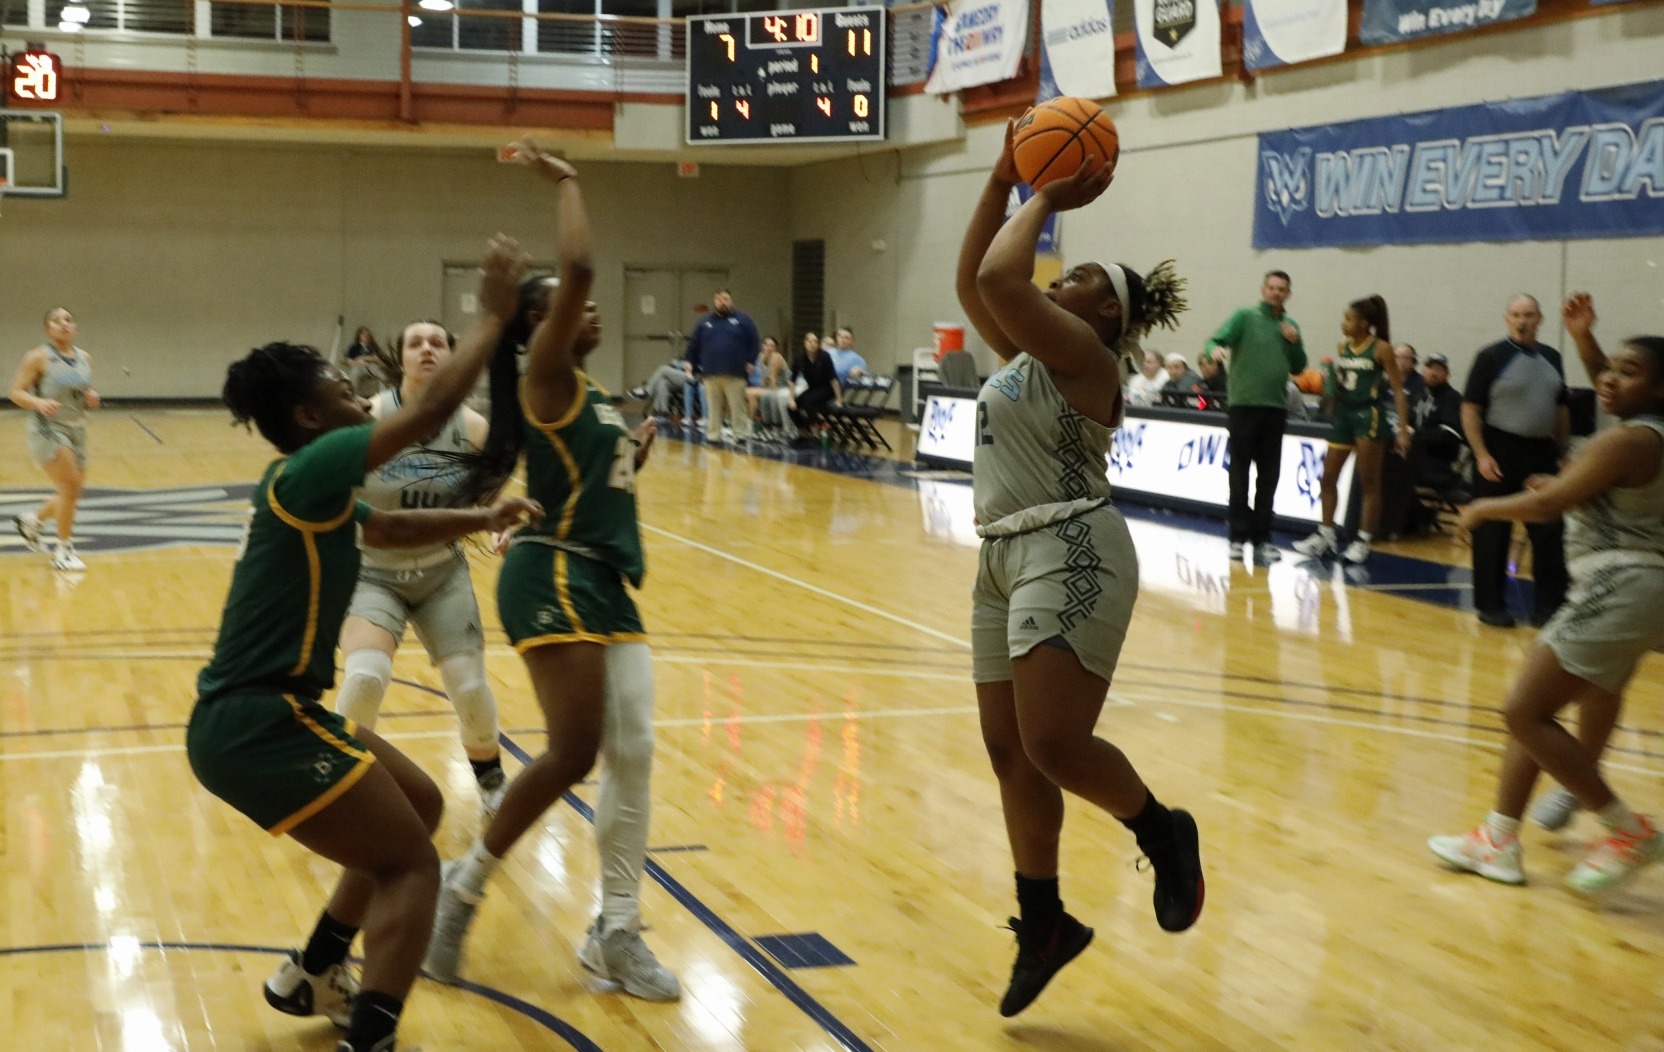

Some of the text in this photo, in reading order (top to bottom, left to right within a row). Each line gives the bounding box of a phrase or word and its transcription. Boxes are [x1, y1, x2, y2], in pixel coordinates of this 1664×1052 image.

[719, 34, 735, 62] 7
[848, 28, 871, 57] 11
[811, 53, 819, 74] 1
[14, 65, 57, 100] 20
[710, 101, 718, 121] 1
[735, 99, 750, 120] 4
[816, 97, 831, 118] 4
[853, 94, 869, 118] 0
[1314, 144, 1410, 218] WIN
[1404, 126, 1590, 213] EVERY
